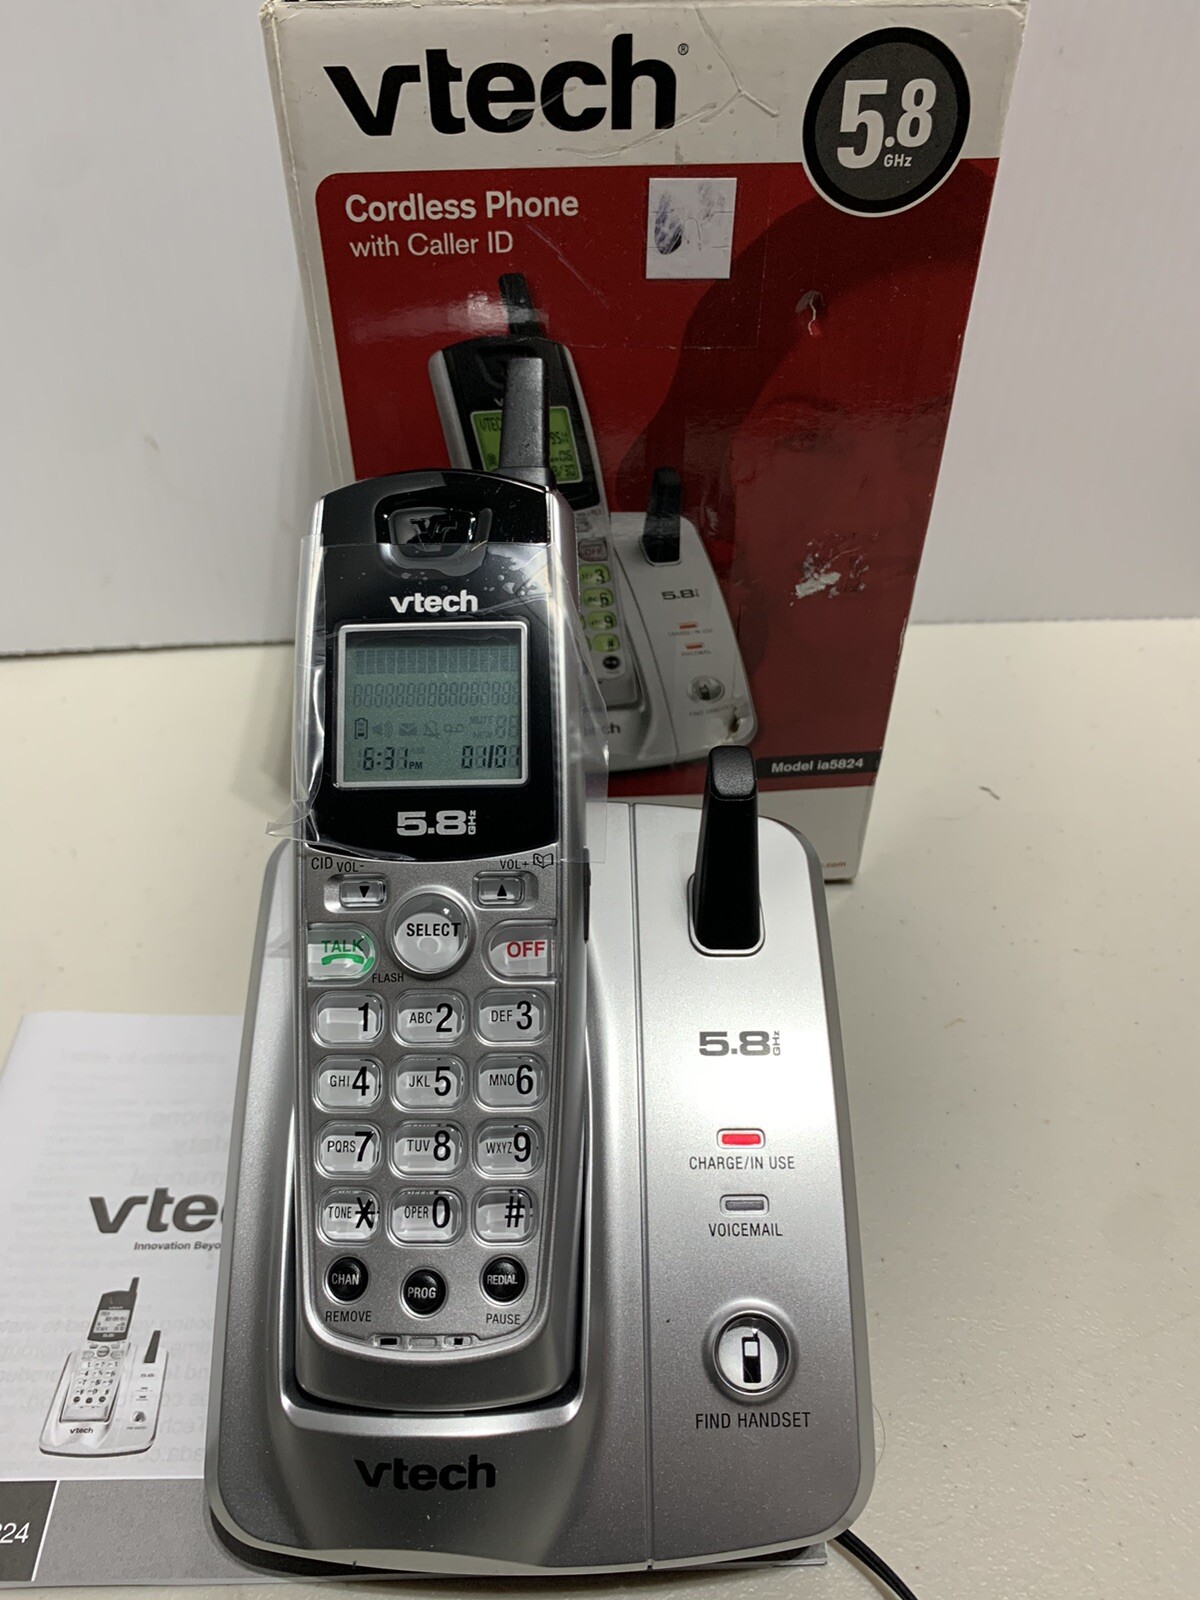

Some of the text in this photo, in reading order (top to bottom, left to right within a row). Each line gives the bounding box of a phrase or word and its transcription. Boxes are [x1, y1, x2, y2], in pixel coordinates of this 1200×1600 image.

[837, 78, 937, 169] 5.8
[883, 153, 913, 168] GHz
[345, 190, 579, 224] Cordless Phone
[349, 231, 514, 258] with Caller ID
[389, 589, 478, 613] vtech
[661, 589, 695, 600] 5.8
[409, 761, 423, 770] PM
[771, 757, 864, 773] Model ia5824
[396, 810, 468, 836] 5.8
[311, 856, 333, 870] CID
[500, 859, 529, 870] VOL+
[406, 922, 461, 938] SELECT
[321, 938, 364, 952] TALK
[506, 941, 546, 958] OFF
[371, 972, 405, 984] FLASH
[358, 1002, 369, 1031] 1
[409, 1003, 453, 1032] ABC 2
[491, 1001, 533, 1030] DEF 3
[698, 1030, 771, 1056] 5.8
[329, 1066, 370, 1096] GHI 4
[408, 1066, 451, 1096] JKL 5
[489, 1064, 534, 1095] MNO 6
[327, 1131, 375, 1162] PQRS 7
[407, 1130, 451, 1161] TUV 8
[485, 1131, 531, 1162] WXYZ 9
[769, 1156, 796, 1170] USE
[328, 1206, 352, 1219] TONE
[404, 1196, 450, 1228] OPER 0
[504, 1195, 526, 1228] #
[708, 1222, 783, 1237] VOICEMAIL
[134, 1241, 191, 1251] Innovation
[331, 1272, 361, 1285] CHAN
[487, 1273, 518, 1285] REDIAL
[407, 1286, 437, 1299] PROG
[325, 1310, 372, 1322] REMOVE
[485, 1313, 521, 1325] PAUSE
[695, 1411, 811, 1429] FIND HANDSET
[70, 1427, 94, 1435] vtech
[353, 1454, 496, 1491] vtech
